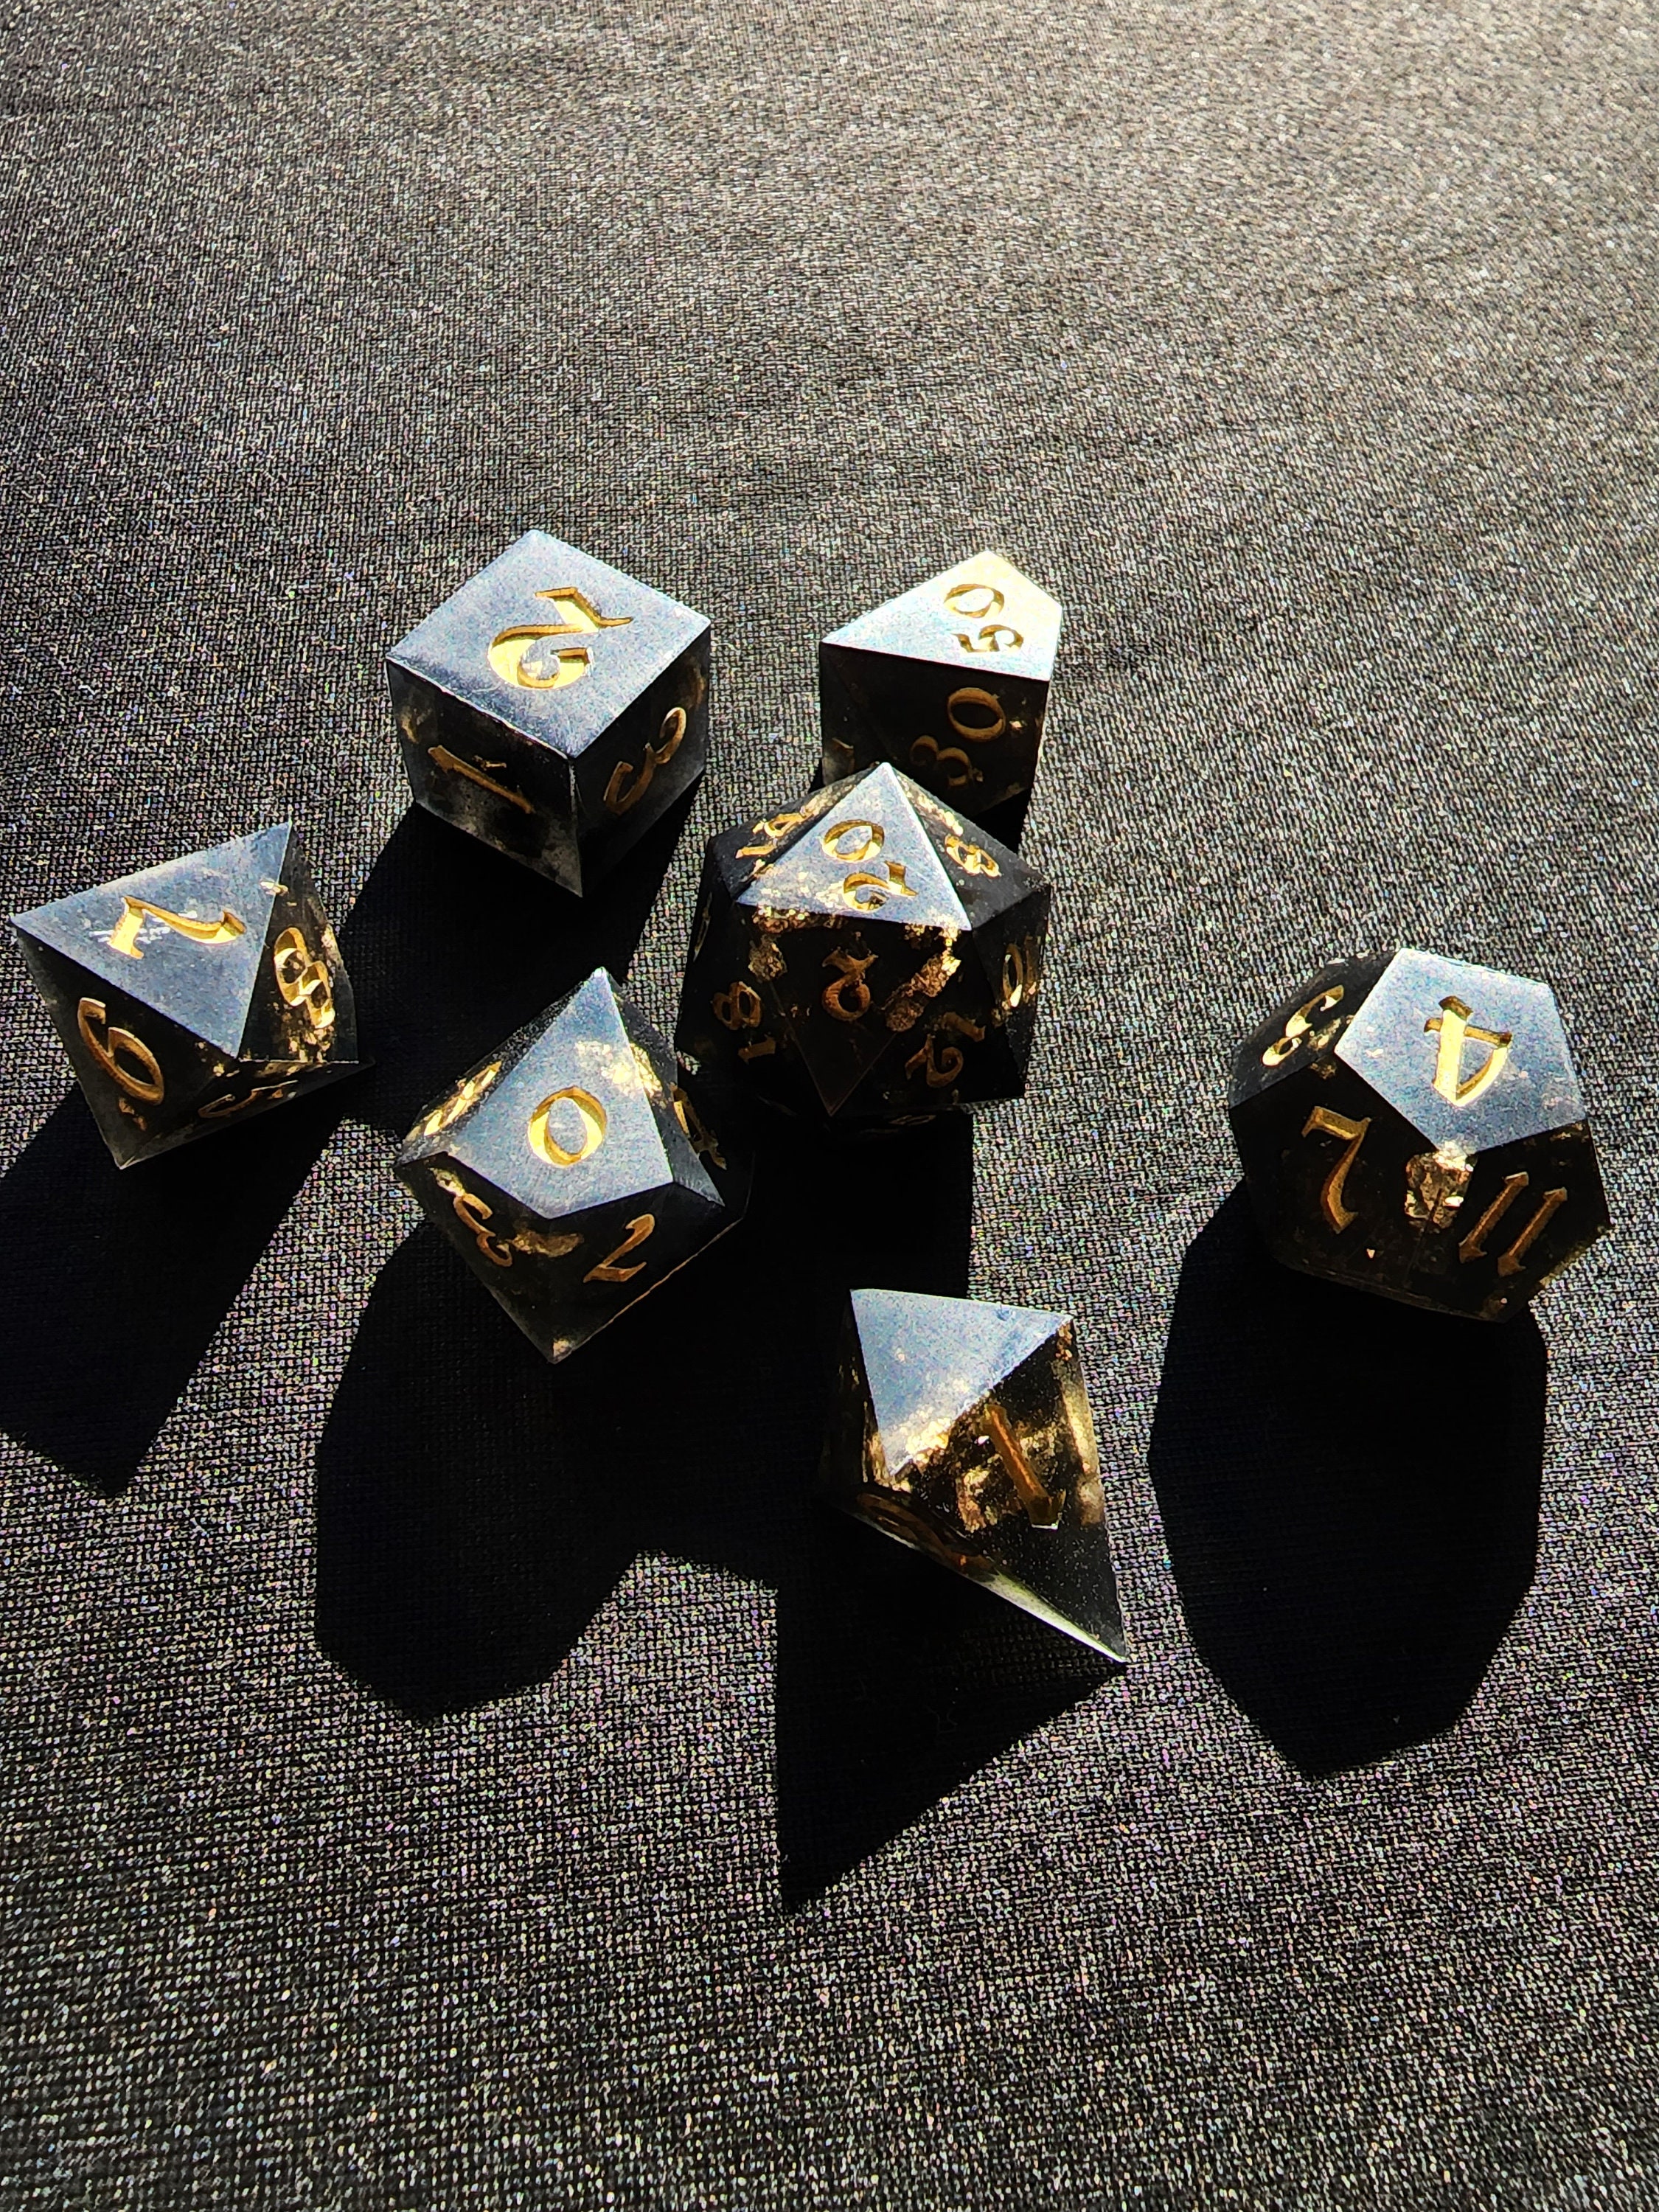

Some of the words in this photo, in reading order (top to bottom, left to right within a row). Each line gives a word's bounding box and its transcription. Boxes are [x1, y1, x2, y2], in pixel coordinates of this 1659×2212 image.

[487, 587, 633, 689] 2
[603, 706, 686, 813] 3
[910, 687, 1006, 787] 30
[821, 819, 919, 911] 20
[945, 833, 1001, 877] 8
[107, 895, 246, 959] 7
[274, 927, 335, 1029] 8
[1424, 995, 1514, 1107] 4
[527, 1085, 608, 1168] 0
[1301, 1106, 1372, 1234] 7
[1459, 1172, 1568, 1277] 11
